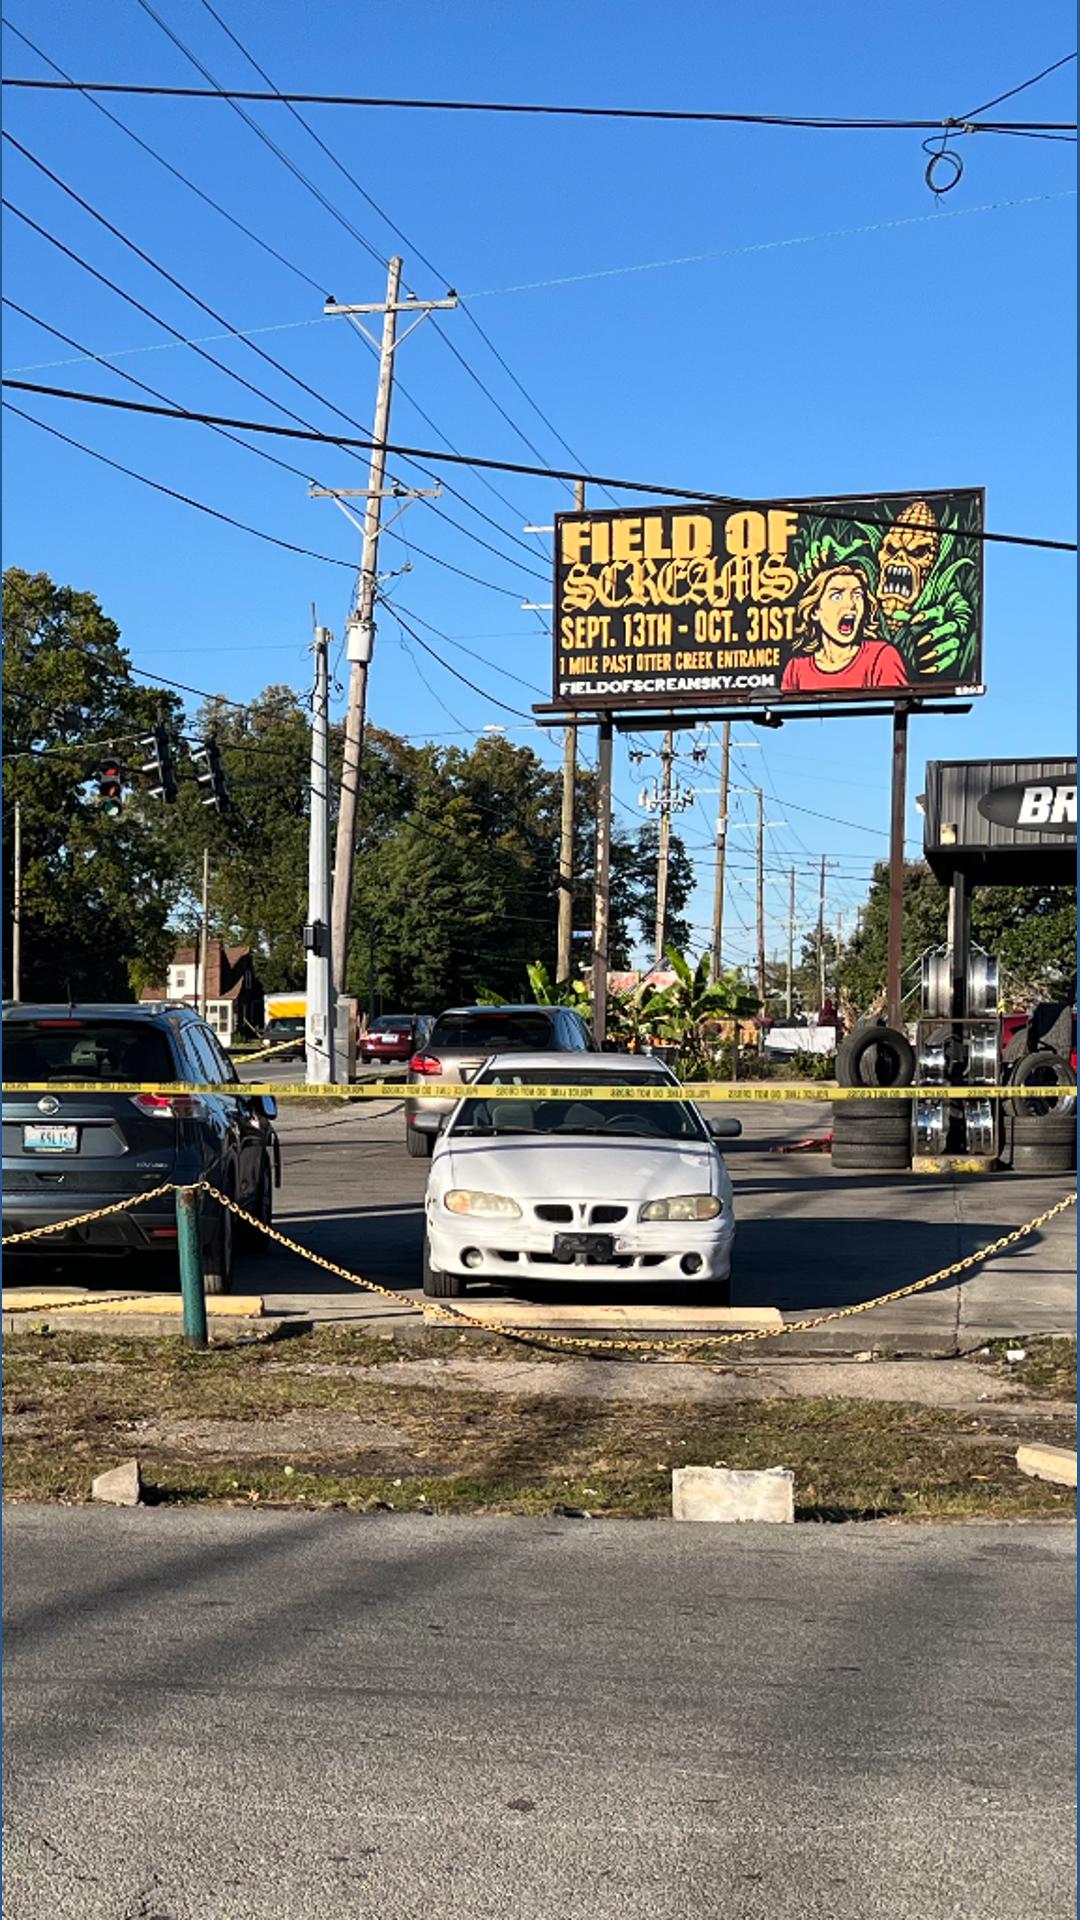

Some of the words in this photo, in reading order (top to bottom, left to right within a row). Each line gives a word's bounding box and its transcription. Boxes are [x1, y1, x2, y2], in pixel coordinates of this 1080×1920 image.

[561, 515, 712, 564] FIELD
[725, 509, 799, 555] OF
[561, 553, 799, 613] SCREAMS
[561, 615, 617, 650] SEPT.
[623, 612, 672, 648] 13TH
[677, 624, 689, 633] -
[694, 609, 740, 643] OCT.
[745, 606, 796, 642] 31ST
[559, 657, 565, 675] 1
[568, 655, 599, 674] MILE
[602, 654, 634, 673] PAST
[636, 652, 672, 672] OTTER
[675, 651, 714, 670] CREEK
[716, 647, 781, 669] ENTRANCE
[560, 674, 776, 696] FIELDOFSCREAMSKY.COM
